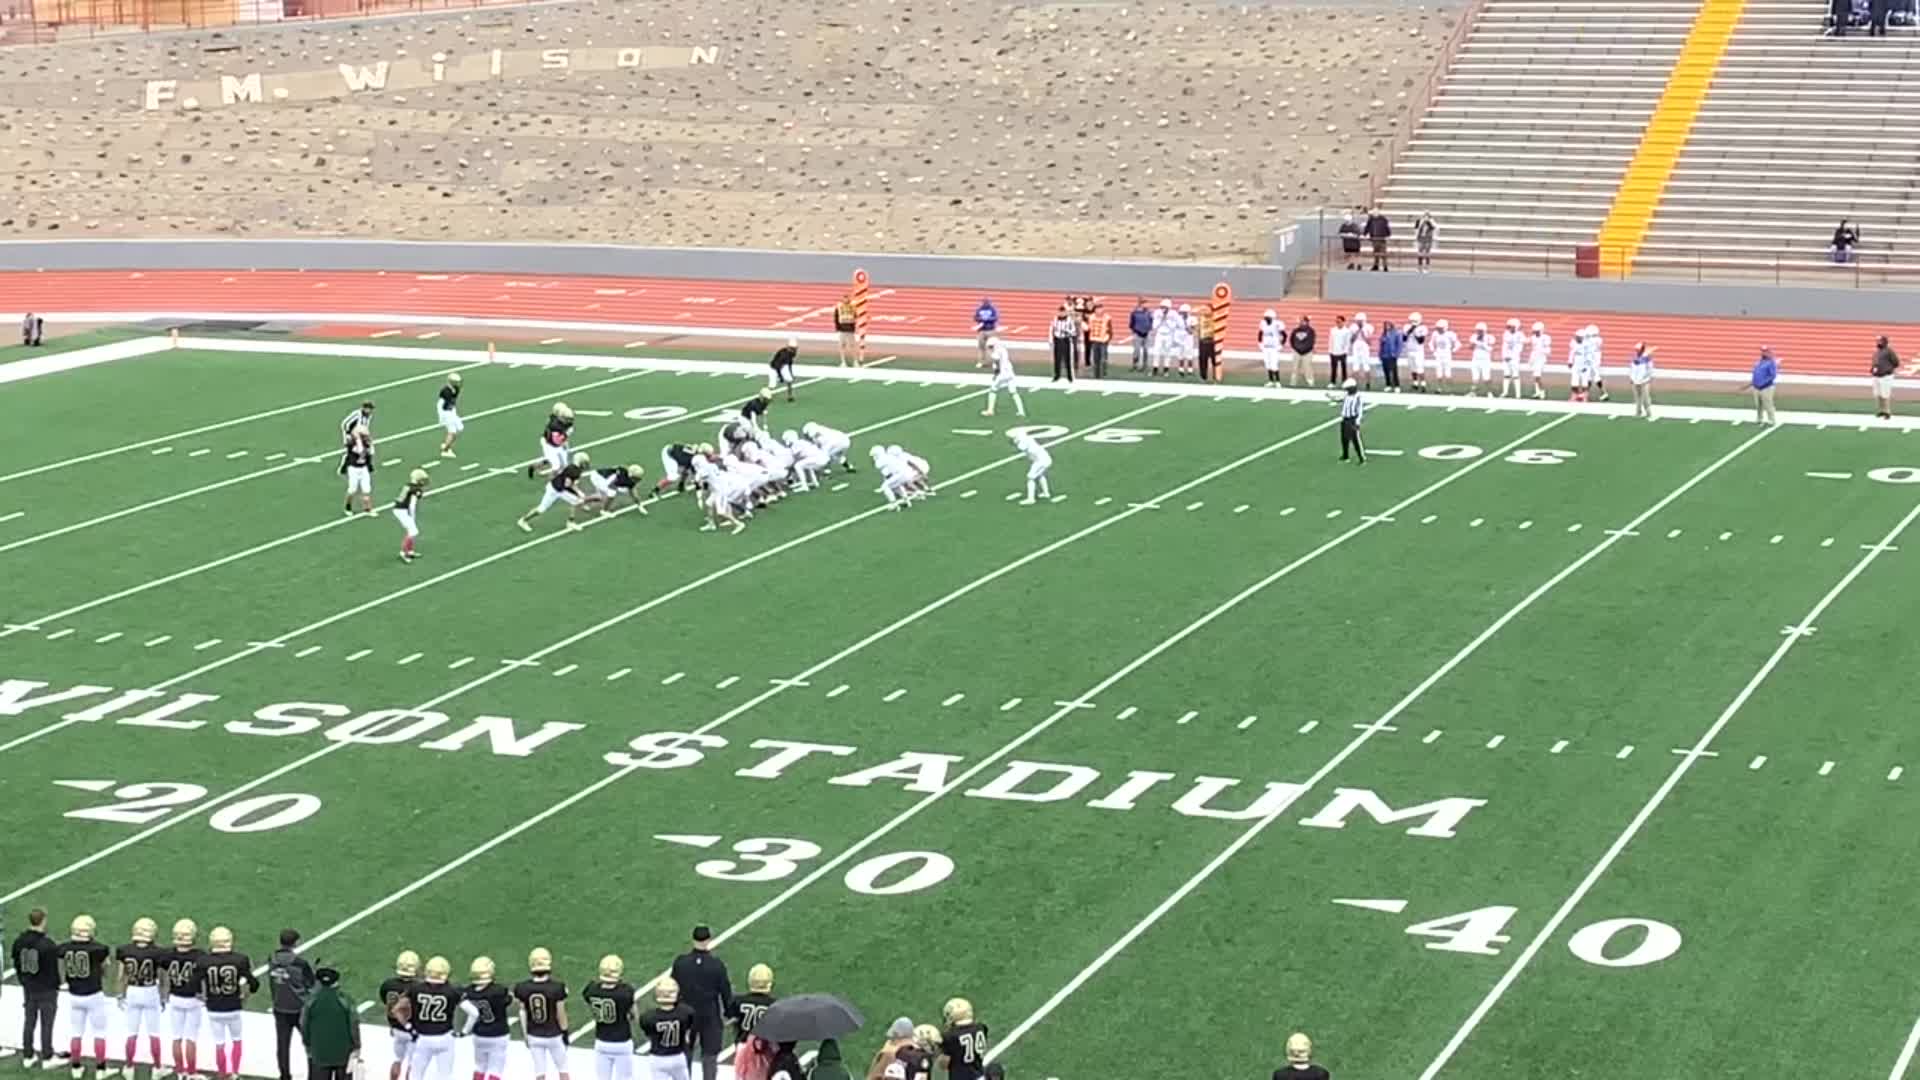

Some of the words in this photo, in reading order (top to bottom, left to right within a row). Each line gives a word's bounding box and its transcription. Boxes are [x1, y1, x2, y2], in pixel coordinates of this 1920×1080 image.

[604, 731, 1487, 839] STADIUM
[63, 782, 322, 832] 20
[694, 837, 955, 896] 30
[1404, 905, 1682, 967] 40
[207, 965, 237, 994] 13
[417, 993, 447, 1022] 72
[529, 993, 548, 1024] 8
[656, 1020, 681, 1047] 71
[959, 1031, 986, 1063] 74
